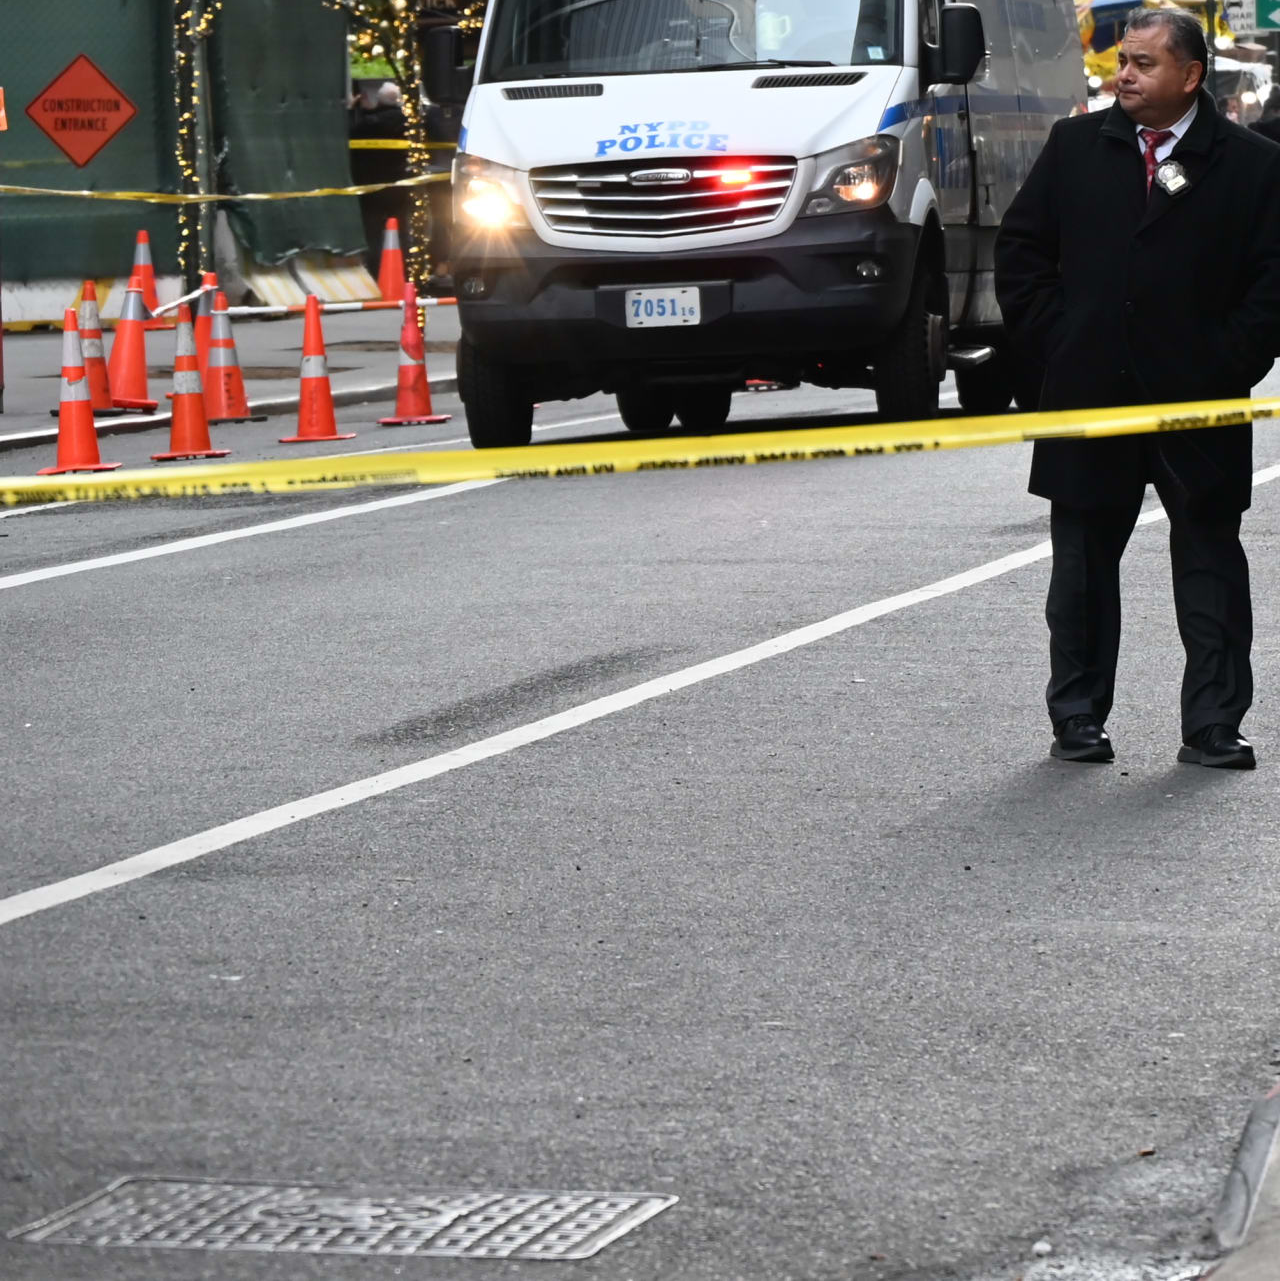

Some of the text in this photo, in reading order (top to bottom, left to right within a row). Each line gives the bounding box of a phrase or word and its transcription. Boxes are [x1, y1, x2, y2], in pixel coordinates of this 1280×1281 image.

[42, 99, 121, 112] CONSTRUCTION
[54, 118, 108, 132] ENTRANCE
[618, 121, 710, 136] NYPD
[595, 133, 729, 158] POLICE
[632, 298, 695, 317] 7051 16
